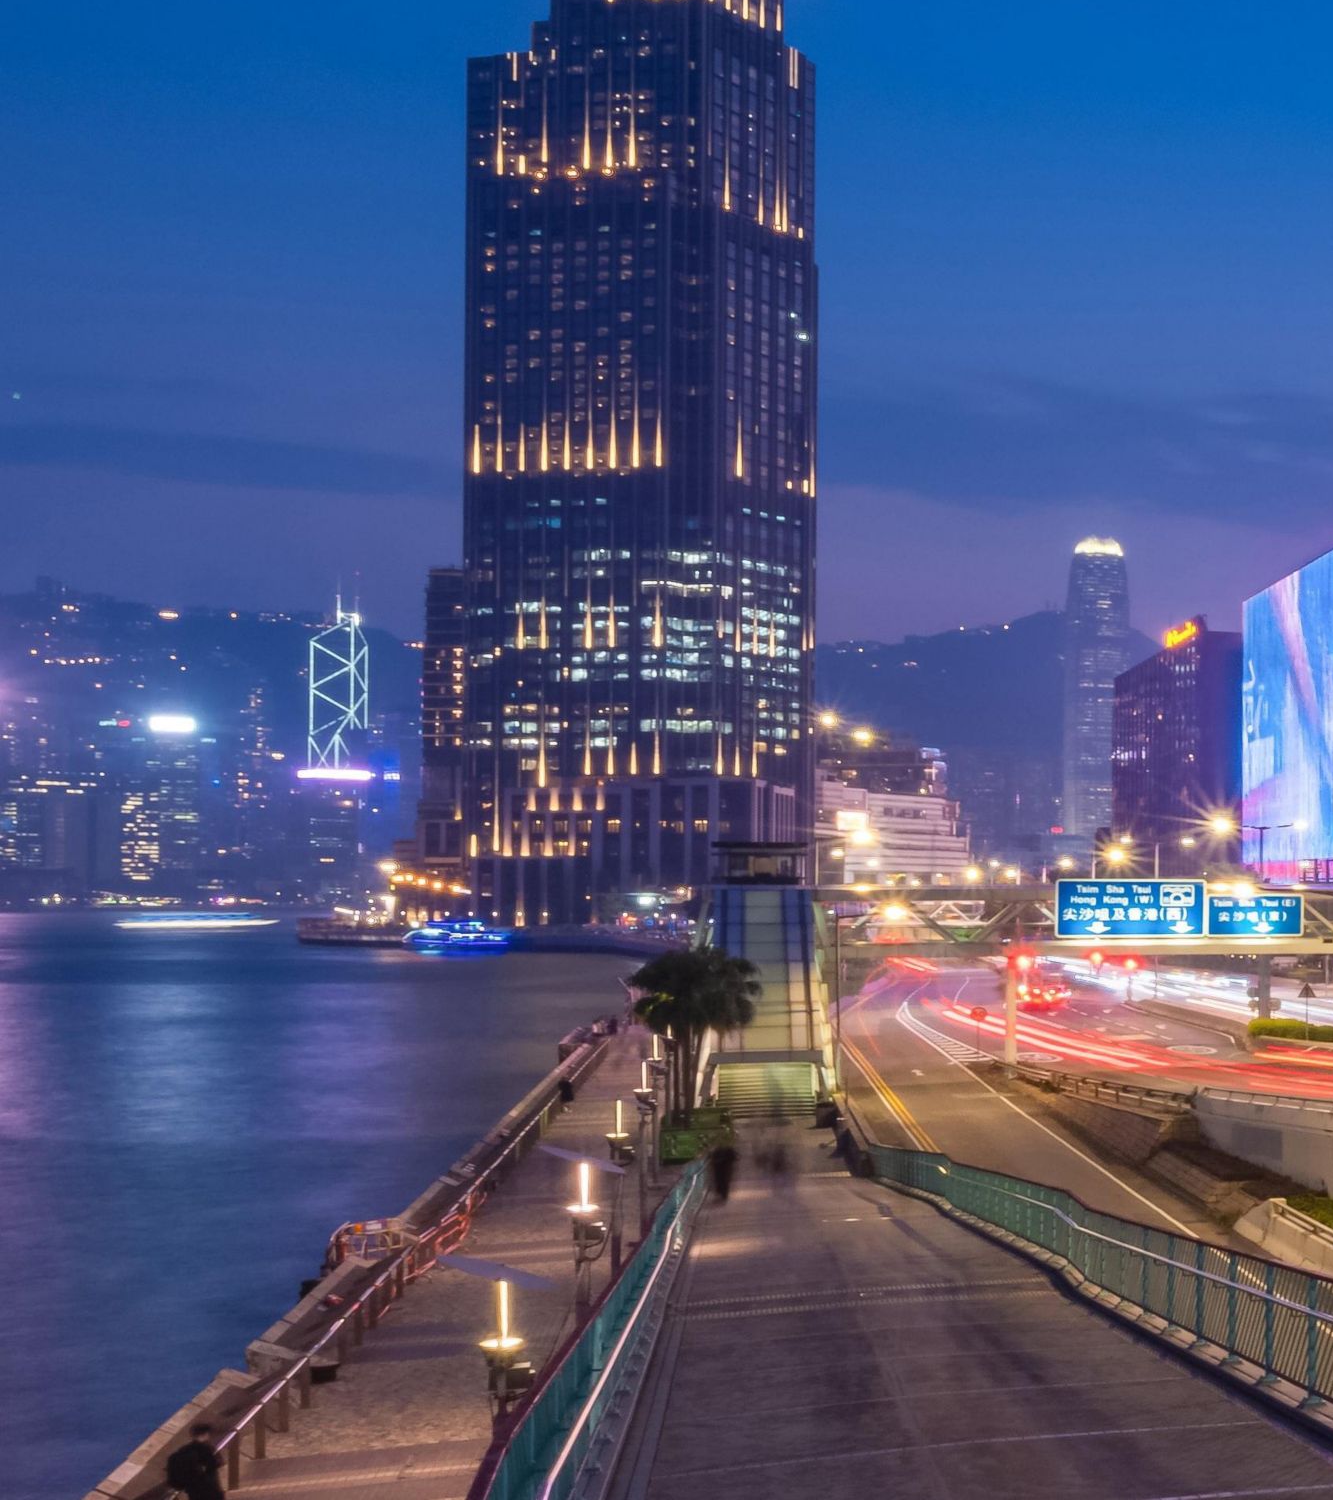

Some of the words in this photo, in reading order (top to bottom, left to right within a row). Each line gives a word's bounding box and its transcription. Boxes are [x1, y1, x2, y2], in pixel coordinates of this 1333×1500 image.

[1076, 885, 1099, 893] Tsim
[1106, 885, 1125, 893] Sha
[1132, 885, 1151, 894] Tsui
[1070, 896, 1097, 905] Hong
[1103, 896, 1129, 906] Kong
[1134, 896, 1154, 904] (W)
[1282, 899, 1296, 907] (E)
